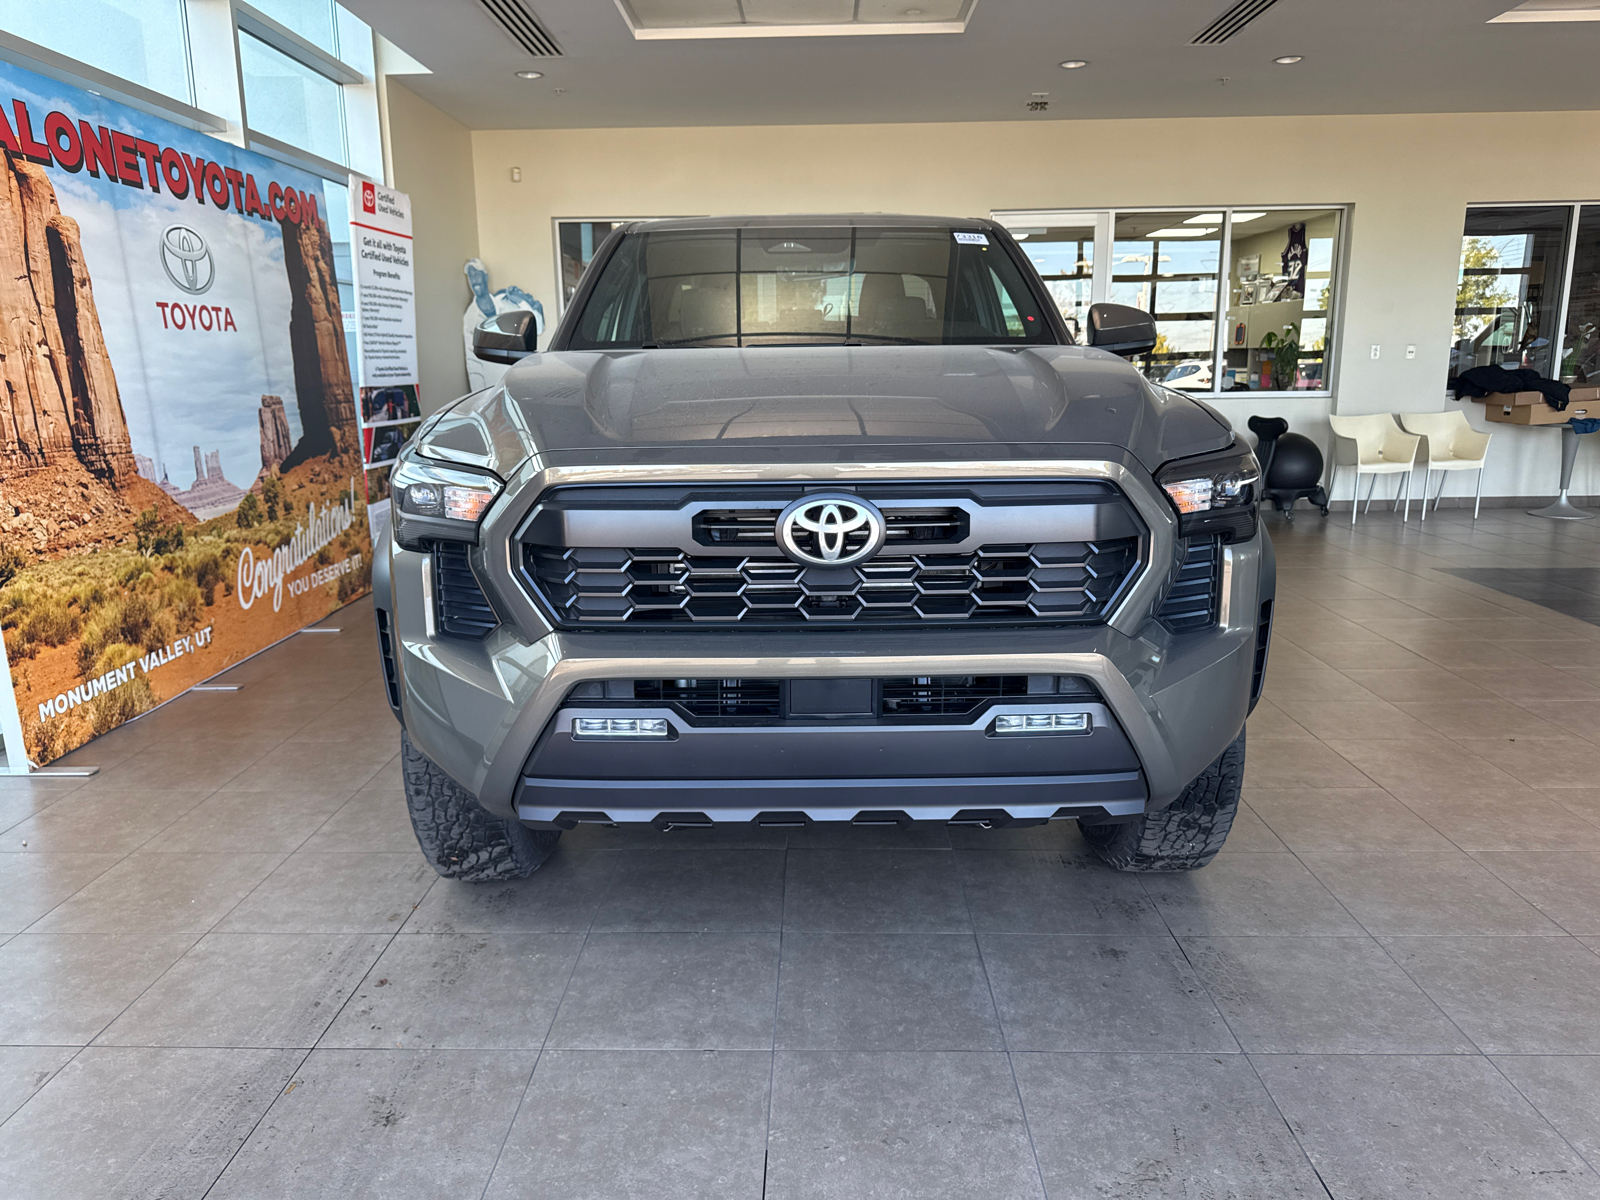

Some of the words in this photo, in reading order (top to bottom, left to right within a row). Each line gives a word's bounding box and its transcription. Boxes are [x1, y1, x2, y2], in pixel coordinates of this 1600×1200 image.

[377, 191, 395, 205] Certified
[378, 203, 388, 214] Used
[389, 206, 405, 219] Vehicles
[361, 249, 381, 262] Certified
[382, 253, 393, 264] Used
[393, 255, 410, 267] Vehicles
[363, 236, 372, 247] Get
[383, 242, 393, 251] with
[392, 243, 407, 255] Toyota
[156, 301, 237, 332] TOYOTA
[237, 476, 356, 613] Congratulations!
[287, 576, 310, 598] YOU
[311, 558, 351, 588] DESERVE
[351, 553, 363, 571] IT!
[38, 661, 137, 723] MONUMENT
[138, 635, 195, 674] VALLEY,
[195, 626, 213, 647] UT
